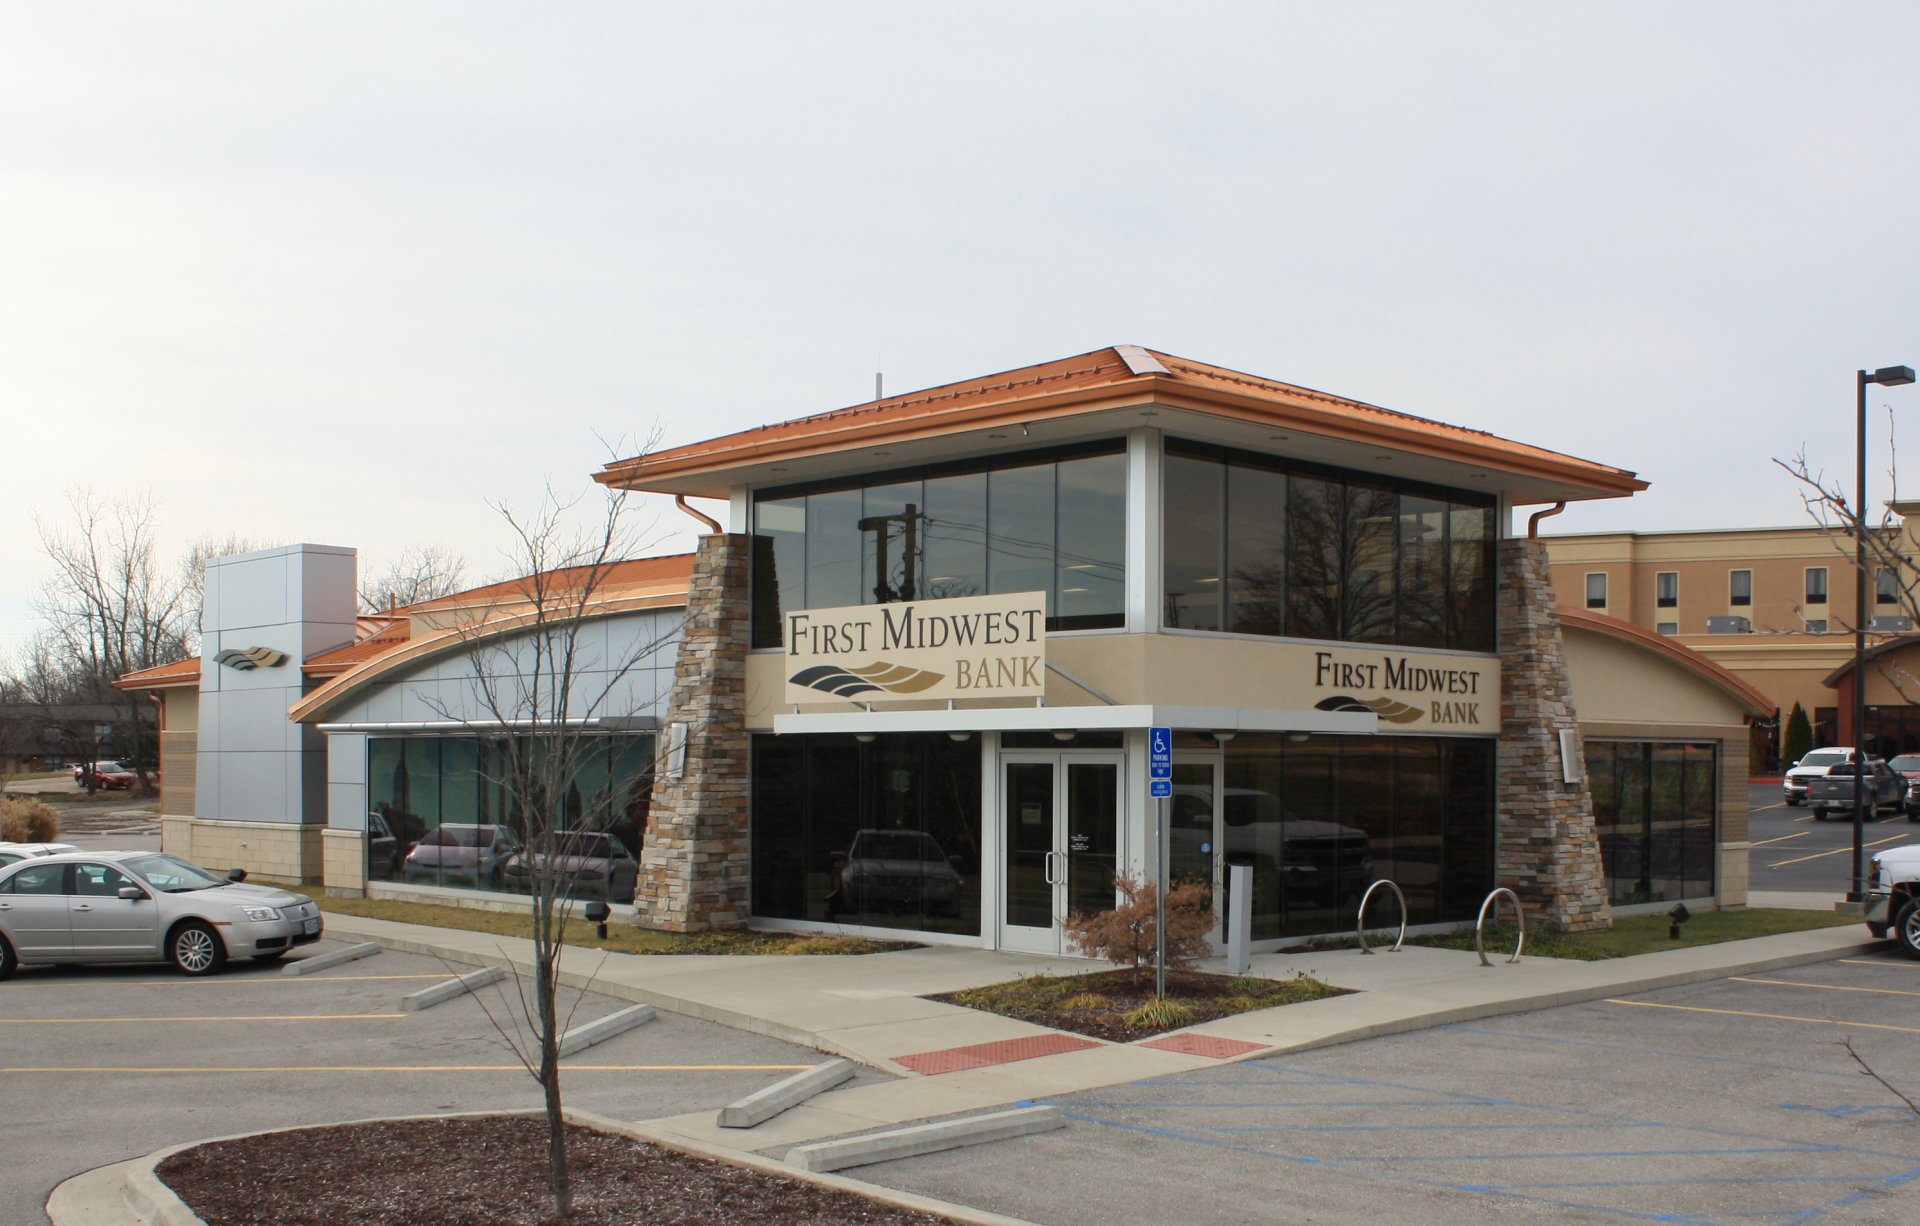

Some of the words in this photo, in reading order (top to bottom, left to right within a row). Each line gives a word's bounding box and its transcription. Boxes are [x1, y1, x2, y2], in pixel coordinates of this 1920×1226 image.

[789, 614, 871, 656] FIRST
[881, 606, 1042, 650] MIDWEST
[955, 656, 1041, 689] BANK
[1314, 652, 1378, 689] FIRST
[1383, 656, 1480, 694] MIDWEST
[1431, 701, 1479, 724] BANK
